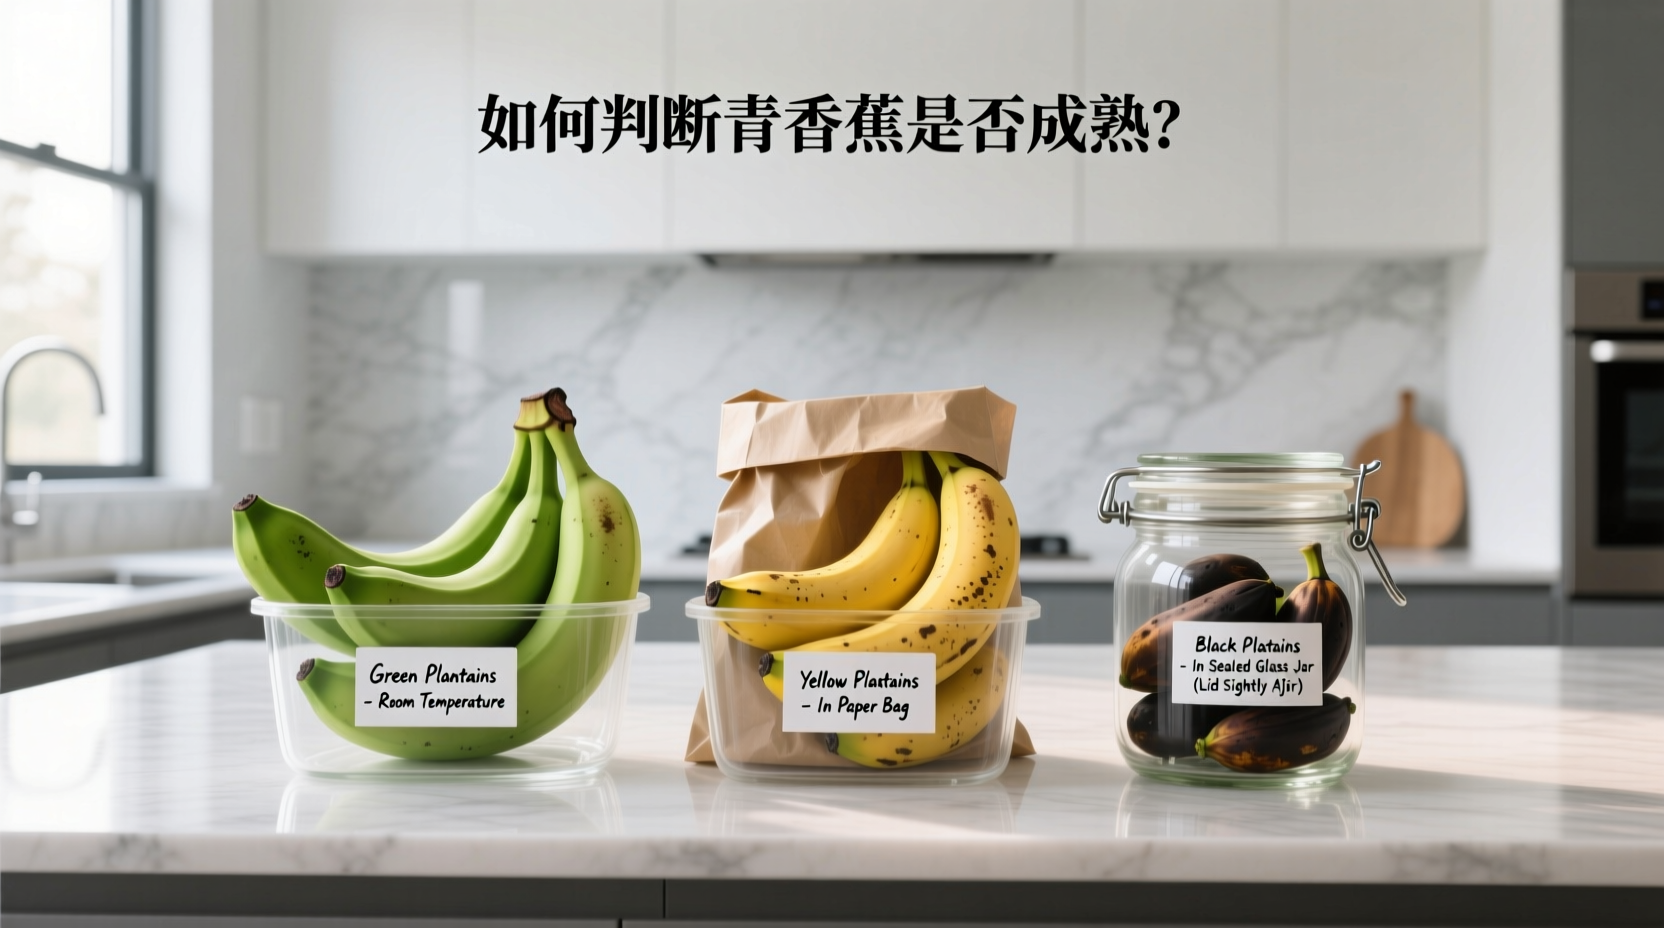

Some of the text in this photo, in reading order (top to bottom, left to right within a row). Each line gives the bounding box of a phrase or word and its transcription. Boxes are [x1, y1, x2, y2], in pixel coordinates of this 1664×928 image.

[1195, 635, 1301, 654] Black Platains
[369, 662, 497, 684] Green Plantains
[1192, 659, 1204, 672] In
[1208, 658, 1251, 673] Sealed
[1255, 658, 1289, 673] Glass
[800, 669, 848, 690] Yellow
[1193, 676, 1219, 695] (Lid
[378, 691, 415, 709] Room
[419, 691, 506, 716] Temperature
[817, 696, 832, 713] In
[837, 695, 879, 721] Paper
[882, 696, 910, 721] Bag
